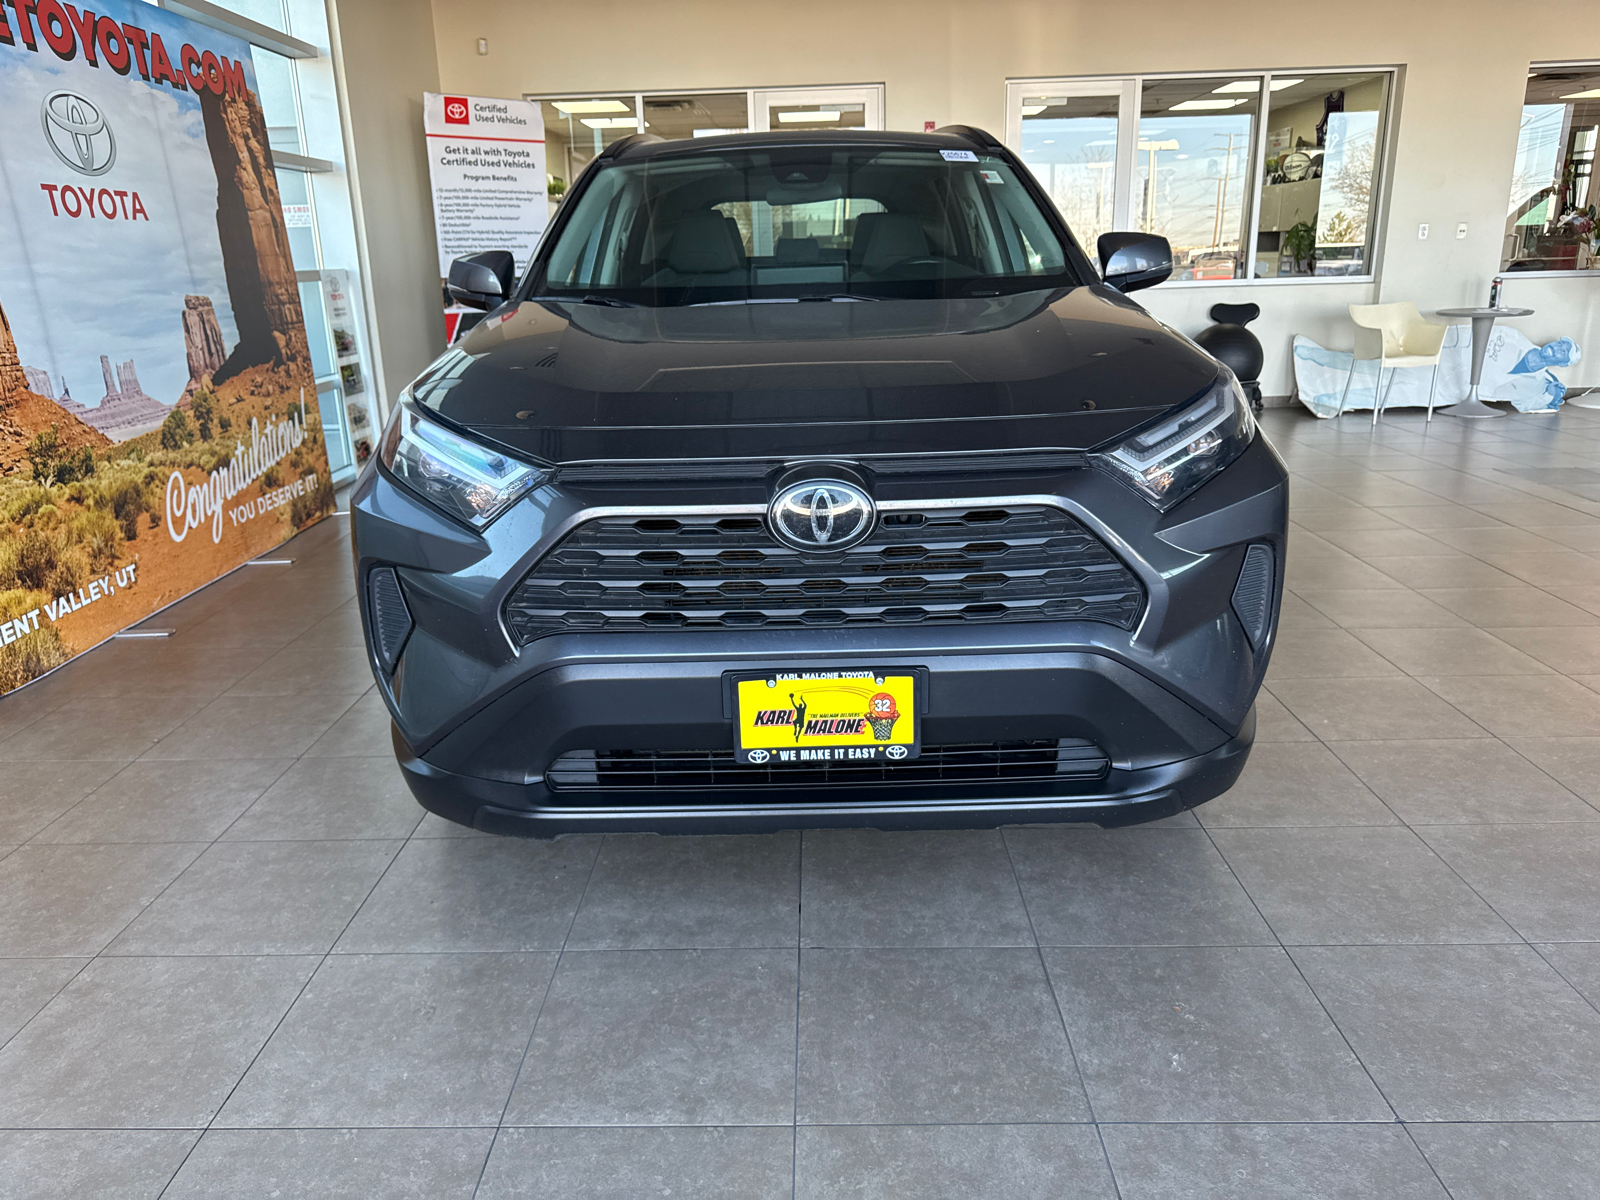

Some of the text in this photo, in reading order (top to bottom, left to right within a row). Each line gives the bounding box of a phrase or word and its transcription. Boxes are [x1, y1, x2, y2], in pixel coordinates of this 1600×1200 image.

[474, 103, 508, 114] Certified
[475, 113, 527, 125] Used Vehicles
[444, 145, 530, 159] Get it all with Toyota
[440, 157, 536, 169] Certified Used Vehicles
[463, 173, 518, 182] Program Benefits
[40, 183, 150, 221] TOYOTA
[165, 386, 309, 544] Congratulations!
[228, 472, 319, 527] YOU DESERVE IT!
[43, 575, 115, 622] VALLEY,
[115, 563, 136, 588] UT
[776, 671, 875, 681] KARL MALONE TOYOTA
[874, 699, 891, 712] 32
[754, 709, 795, 727] KARL
[803, 718, 866, 736] MALONE
[779, 747, 876, 762] WE MAKE IT EASY
